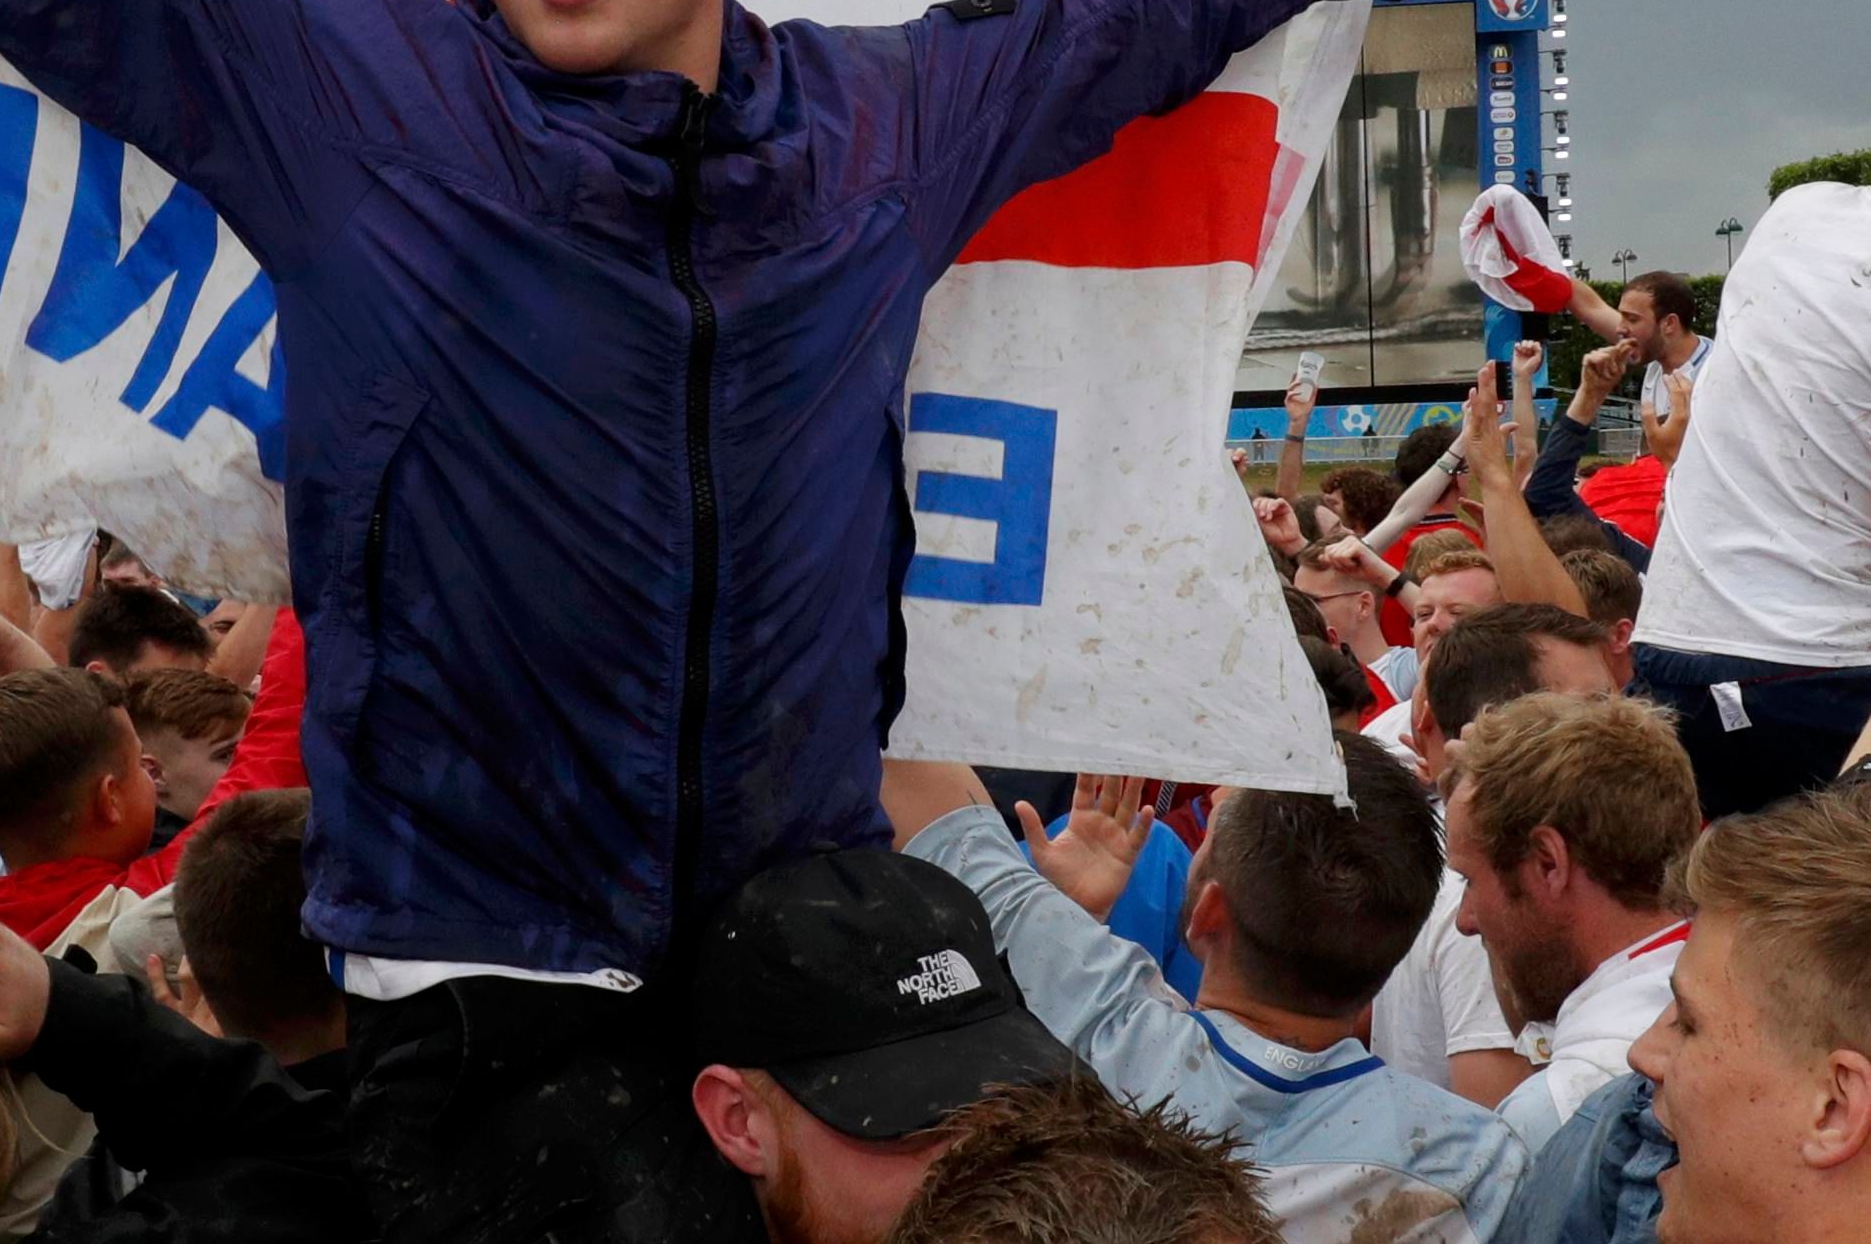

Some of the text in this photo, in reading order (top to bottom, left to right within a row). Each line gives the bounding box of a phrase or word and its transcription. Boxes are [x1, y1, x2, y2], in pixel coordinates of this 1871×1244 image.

[917, 950, 950, 972] THE
[896, 966, 954, 995] NORTH
[917, 979, 959, 1005] FACE
